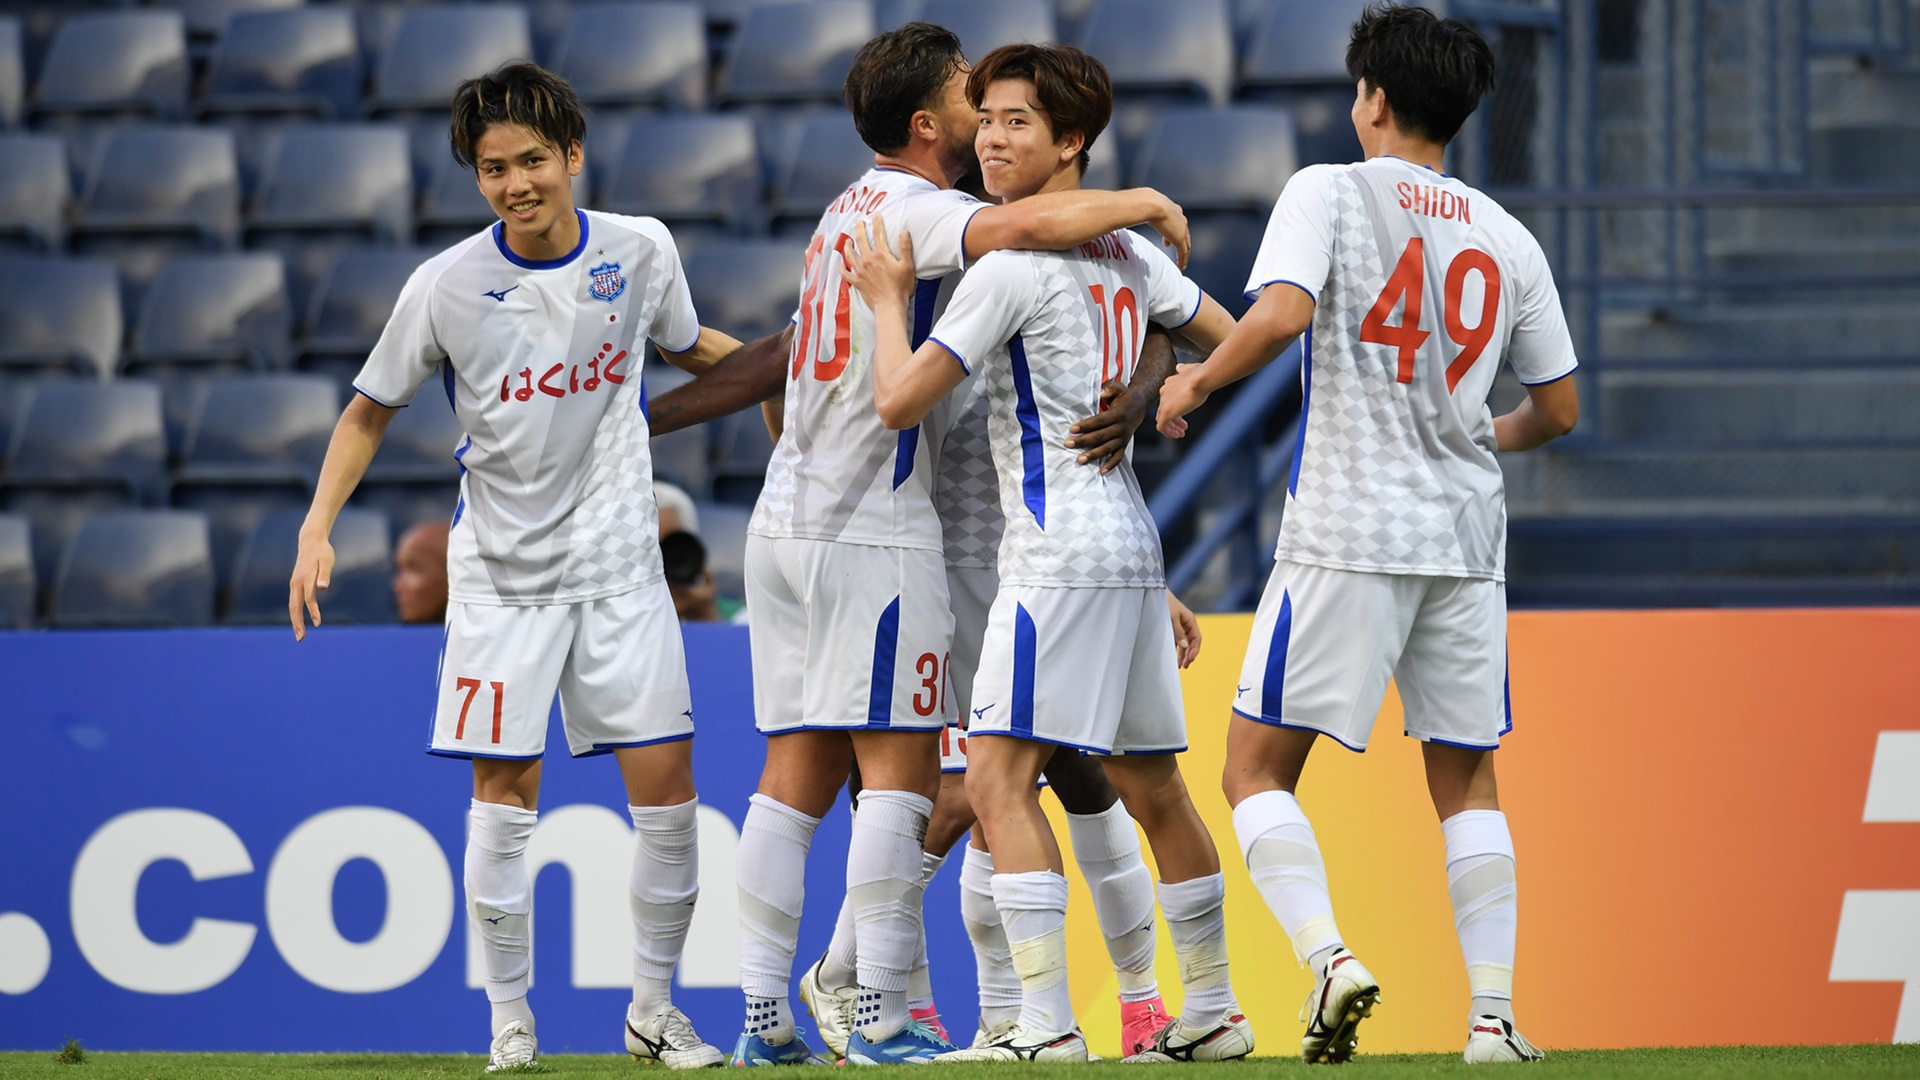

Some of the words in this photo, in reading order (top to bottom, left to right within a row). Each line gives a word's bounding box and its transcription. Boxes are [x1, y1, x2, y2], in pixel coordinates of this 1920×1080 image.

[1396, 181, 1472, 225] SHION
[792, 232, 854, 381] 30
[1087, 283, 1139, 413] 10
[1359, 236, 1501, 396] 49
[499, 342, 628, 403] はくばく
[455, 676, 504, 744] 71
